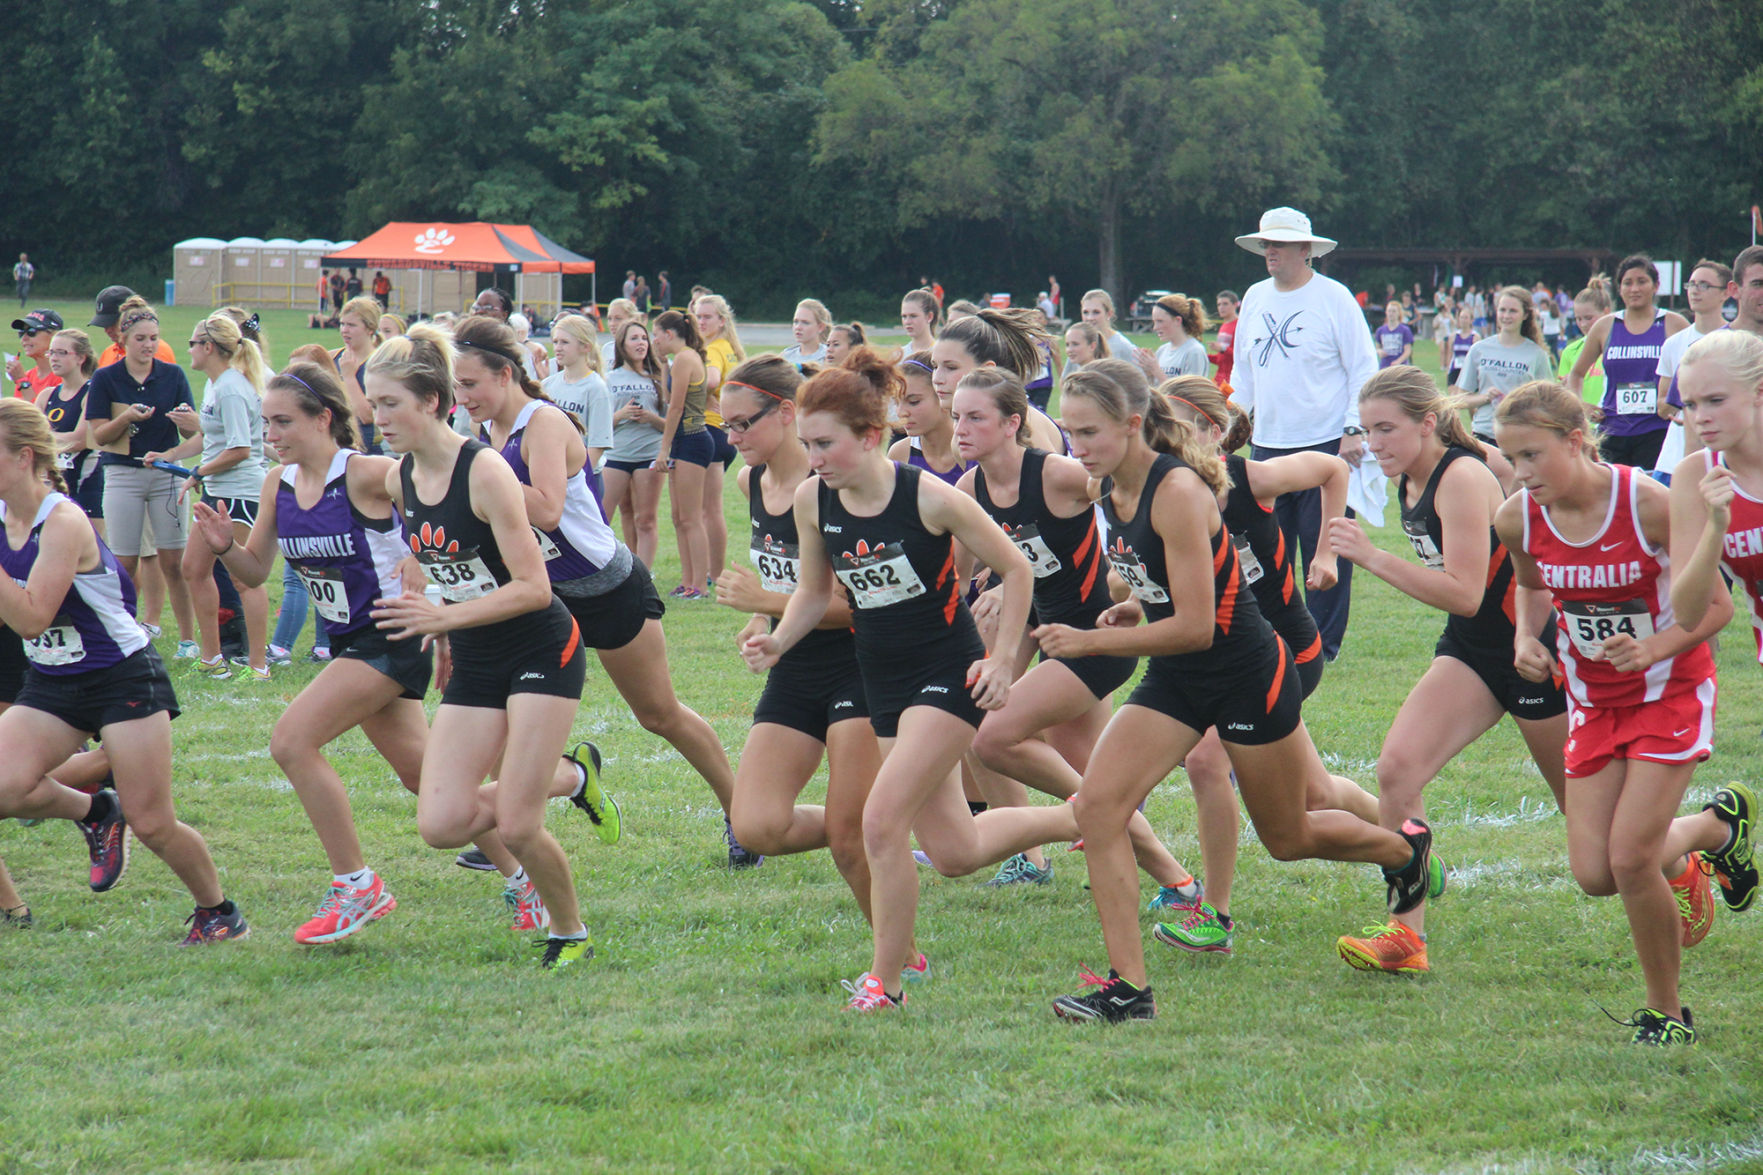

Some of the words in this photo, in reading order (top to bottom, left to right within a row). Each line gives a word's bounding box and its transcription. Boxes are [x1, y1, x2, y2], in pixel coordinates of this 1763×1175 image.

[1623, 391, 1647, 403] 607
[430, 563, 475, 585] 638
[758, 555, 797, 583] 634
[849, 564, 901, 592] 662
[1577, 616, 1637, 641] 584
